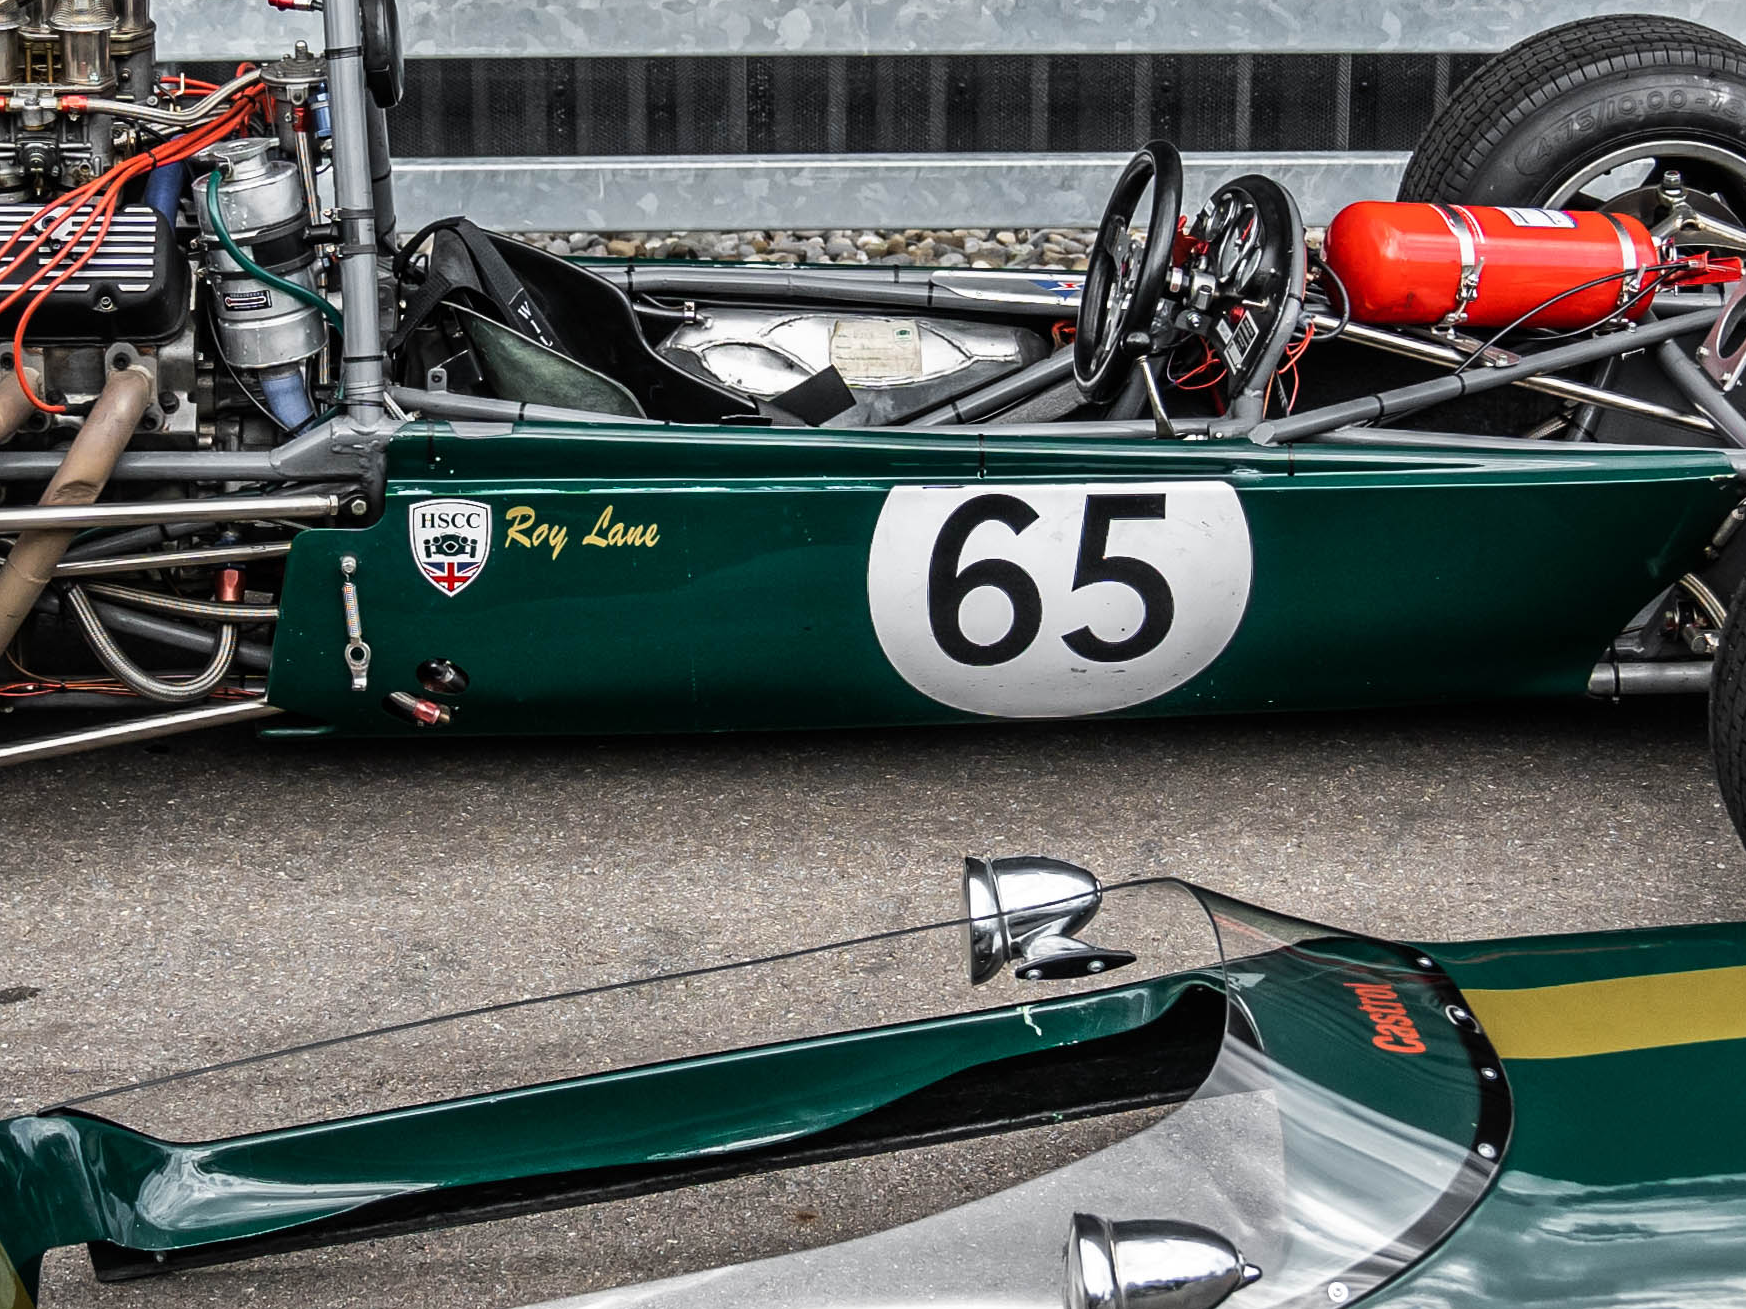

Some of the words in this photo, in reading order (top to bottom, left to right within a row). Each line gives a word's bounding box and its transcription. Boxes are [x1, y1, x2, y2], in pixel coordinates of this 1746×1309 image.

[421, 512, 481, 529] HSCC
[505, 505, 569, 561] Roy
[582, 504, 661, 548] Lane
[928, 492, 1175, 667] 65
[1343, 982, 1427, 1053] Castrol
